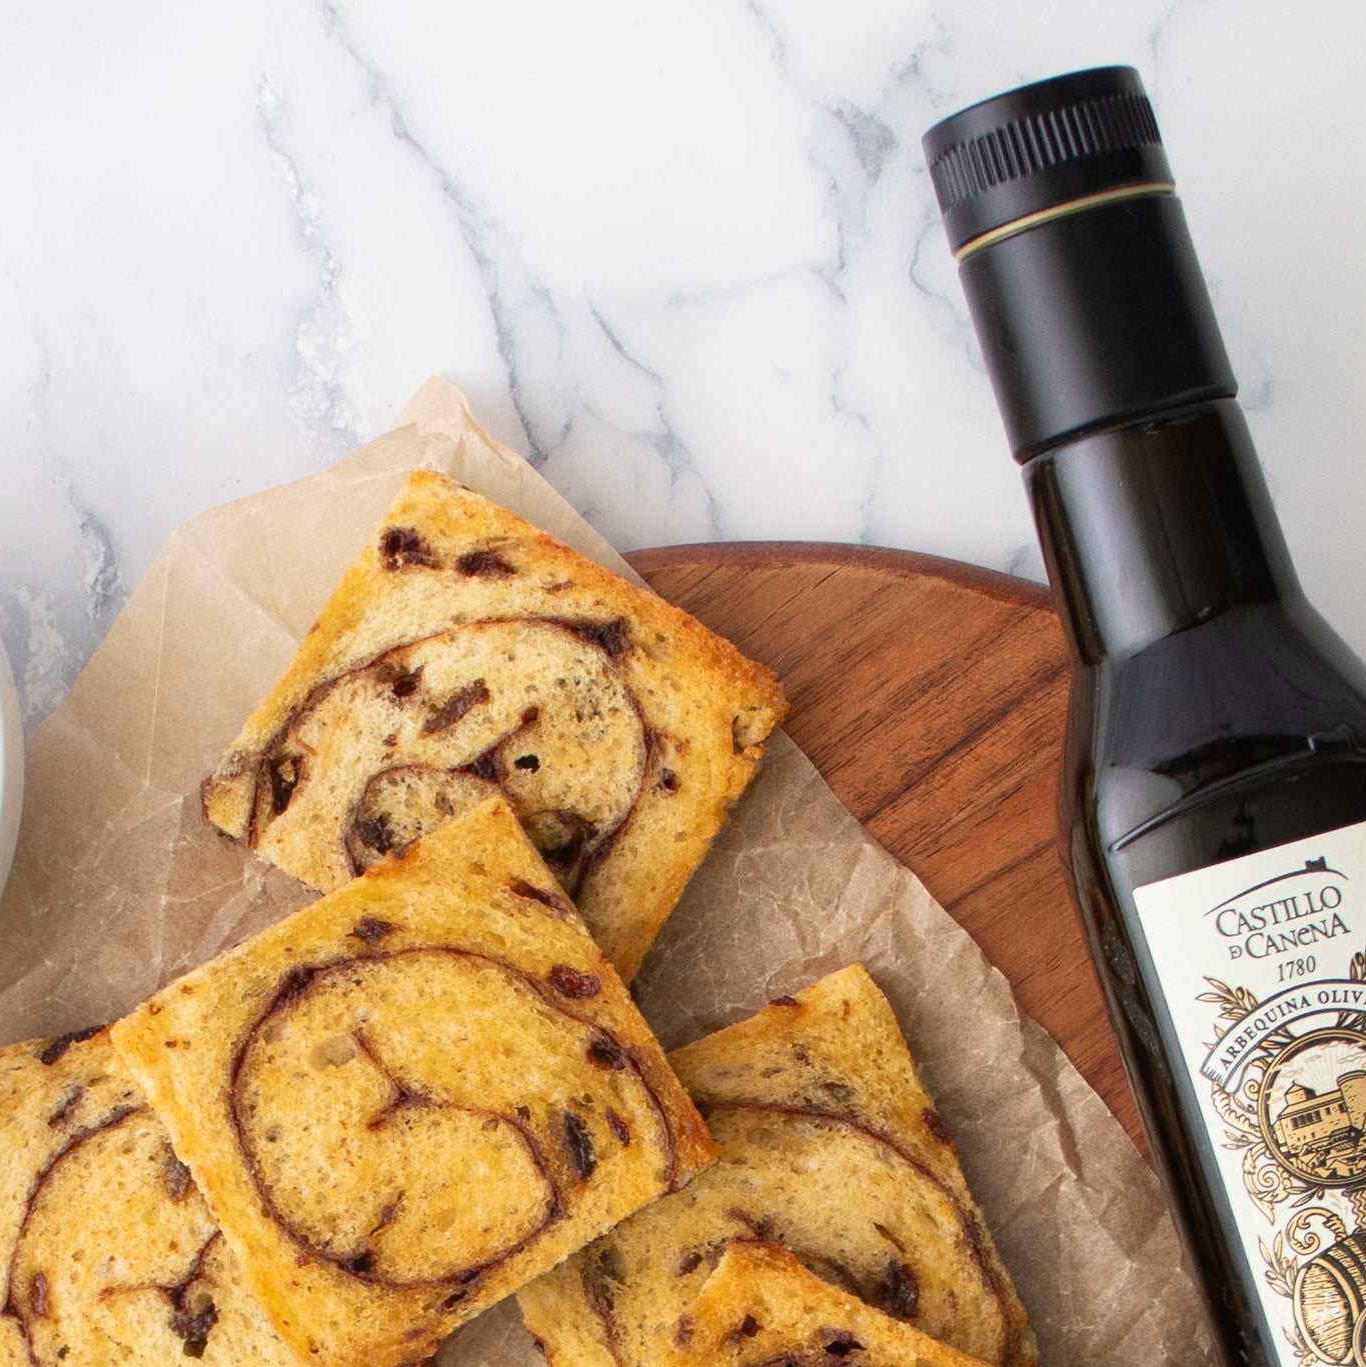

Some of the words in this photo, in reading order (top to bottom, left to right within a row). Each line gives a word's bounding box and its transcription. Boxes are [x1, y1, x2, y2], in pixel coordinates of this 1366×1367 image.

[1215, 885, 1342, 937] CASTILLO
[1278, 955, 1316, 982] 1780
[1220, 995, 1312, 1070] ARBEQUINA
